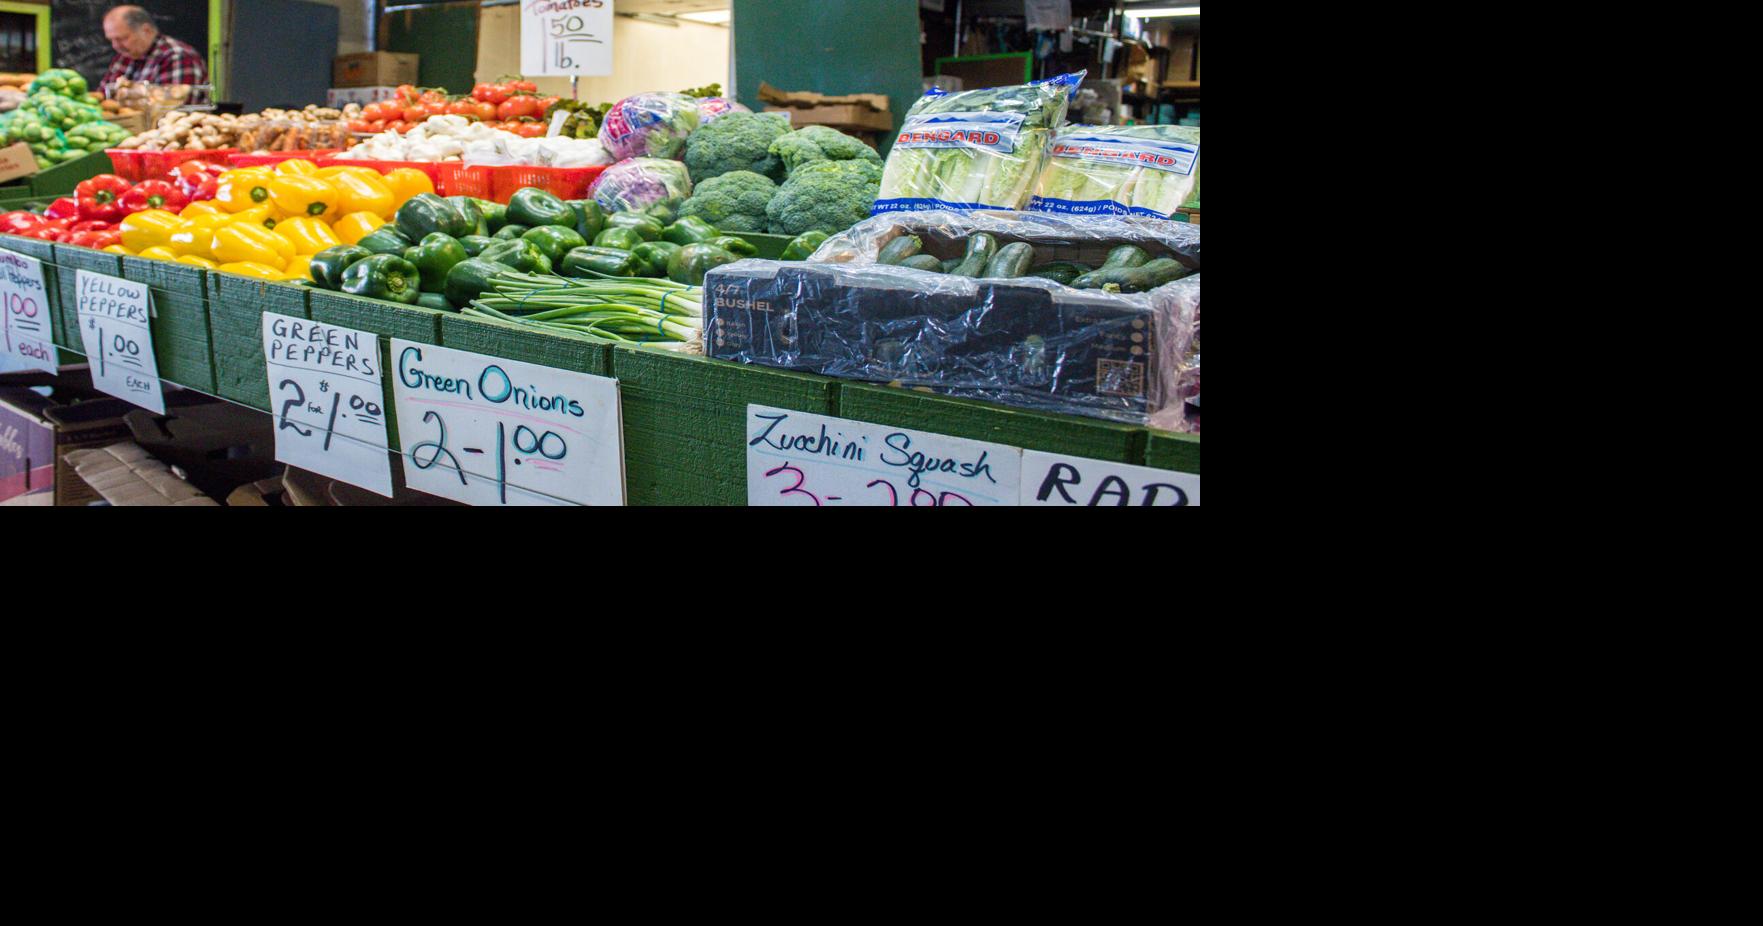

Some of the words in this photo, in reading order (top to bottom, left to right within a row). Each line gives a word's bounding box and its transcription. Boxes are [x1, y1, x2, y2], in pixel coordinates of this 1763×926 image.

[554, 41, 580, 69] lb.
[82, 276, 140, 299] YELLOW
[80, 296, 147, 323] PEPPERS
[716, 297, 775, 312] BUSHEL
[272, 319, 359, 350] GREEN
[19, 342, 50, 361] each
[271, 339, 374, 376] PEPPERS
[126, 375, 151, 391] EACH
[400, 346, 473, 400] Green
[478, 364, 585, 417] Onions
[880, 432, 997, 488] Squash
